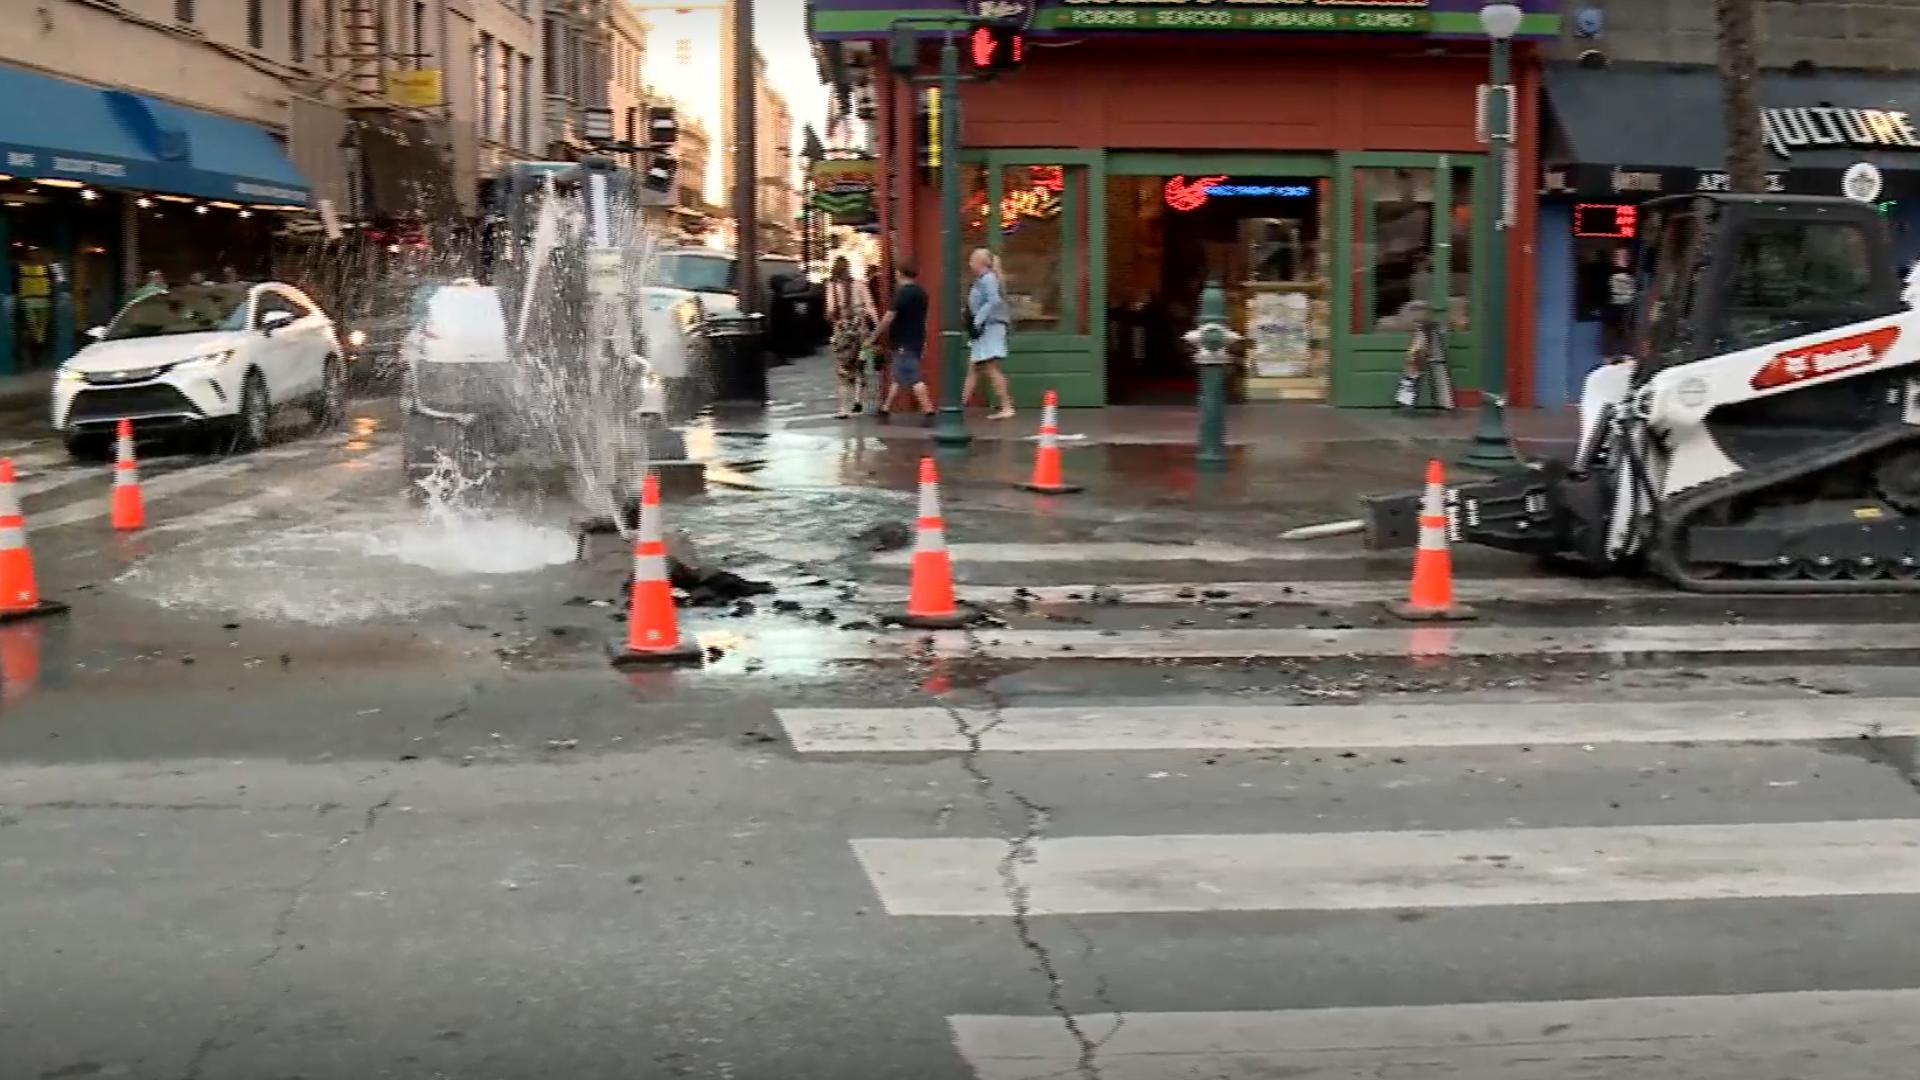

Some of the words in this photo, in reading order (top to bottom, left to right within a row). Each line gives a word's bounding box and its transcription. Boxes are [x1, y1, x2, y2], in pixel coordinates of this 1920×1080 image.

[1071, 10, 1137, 26] POBOYS
[1155, 10, 1232, 26] SEAFOOD
[1251, 12, 1335, 27] JAMBALAYA
[1354, 13, 1413, 28] GUMBO
